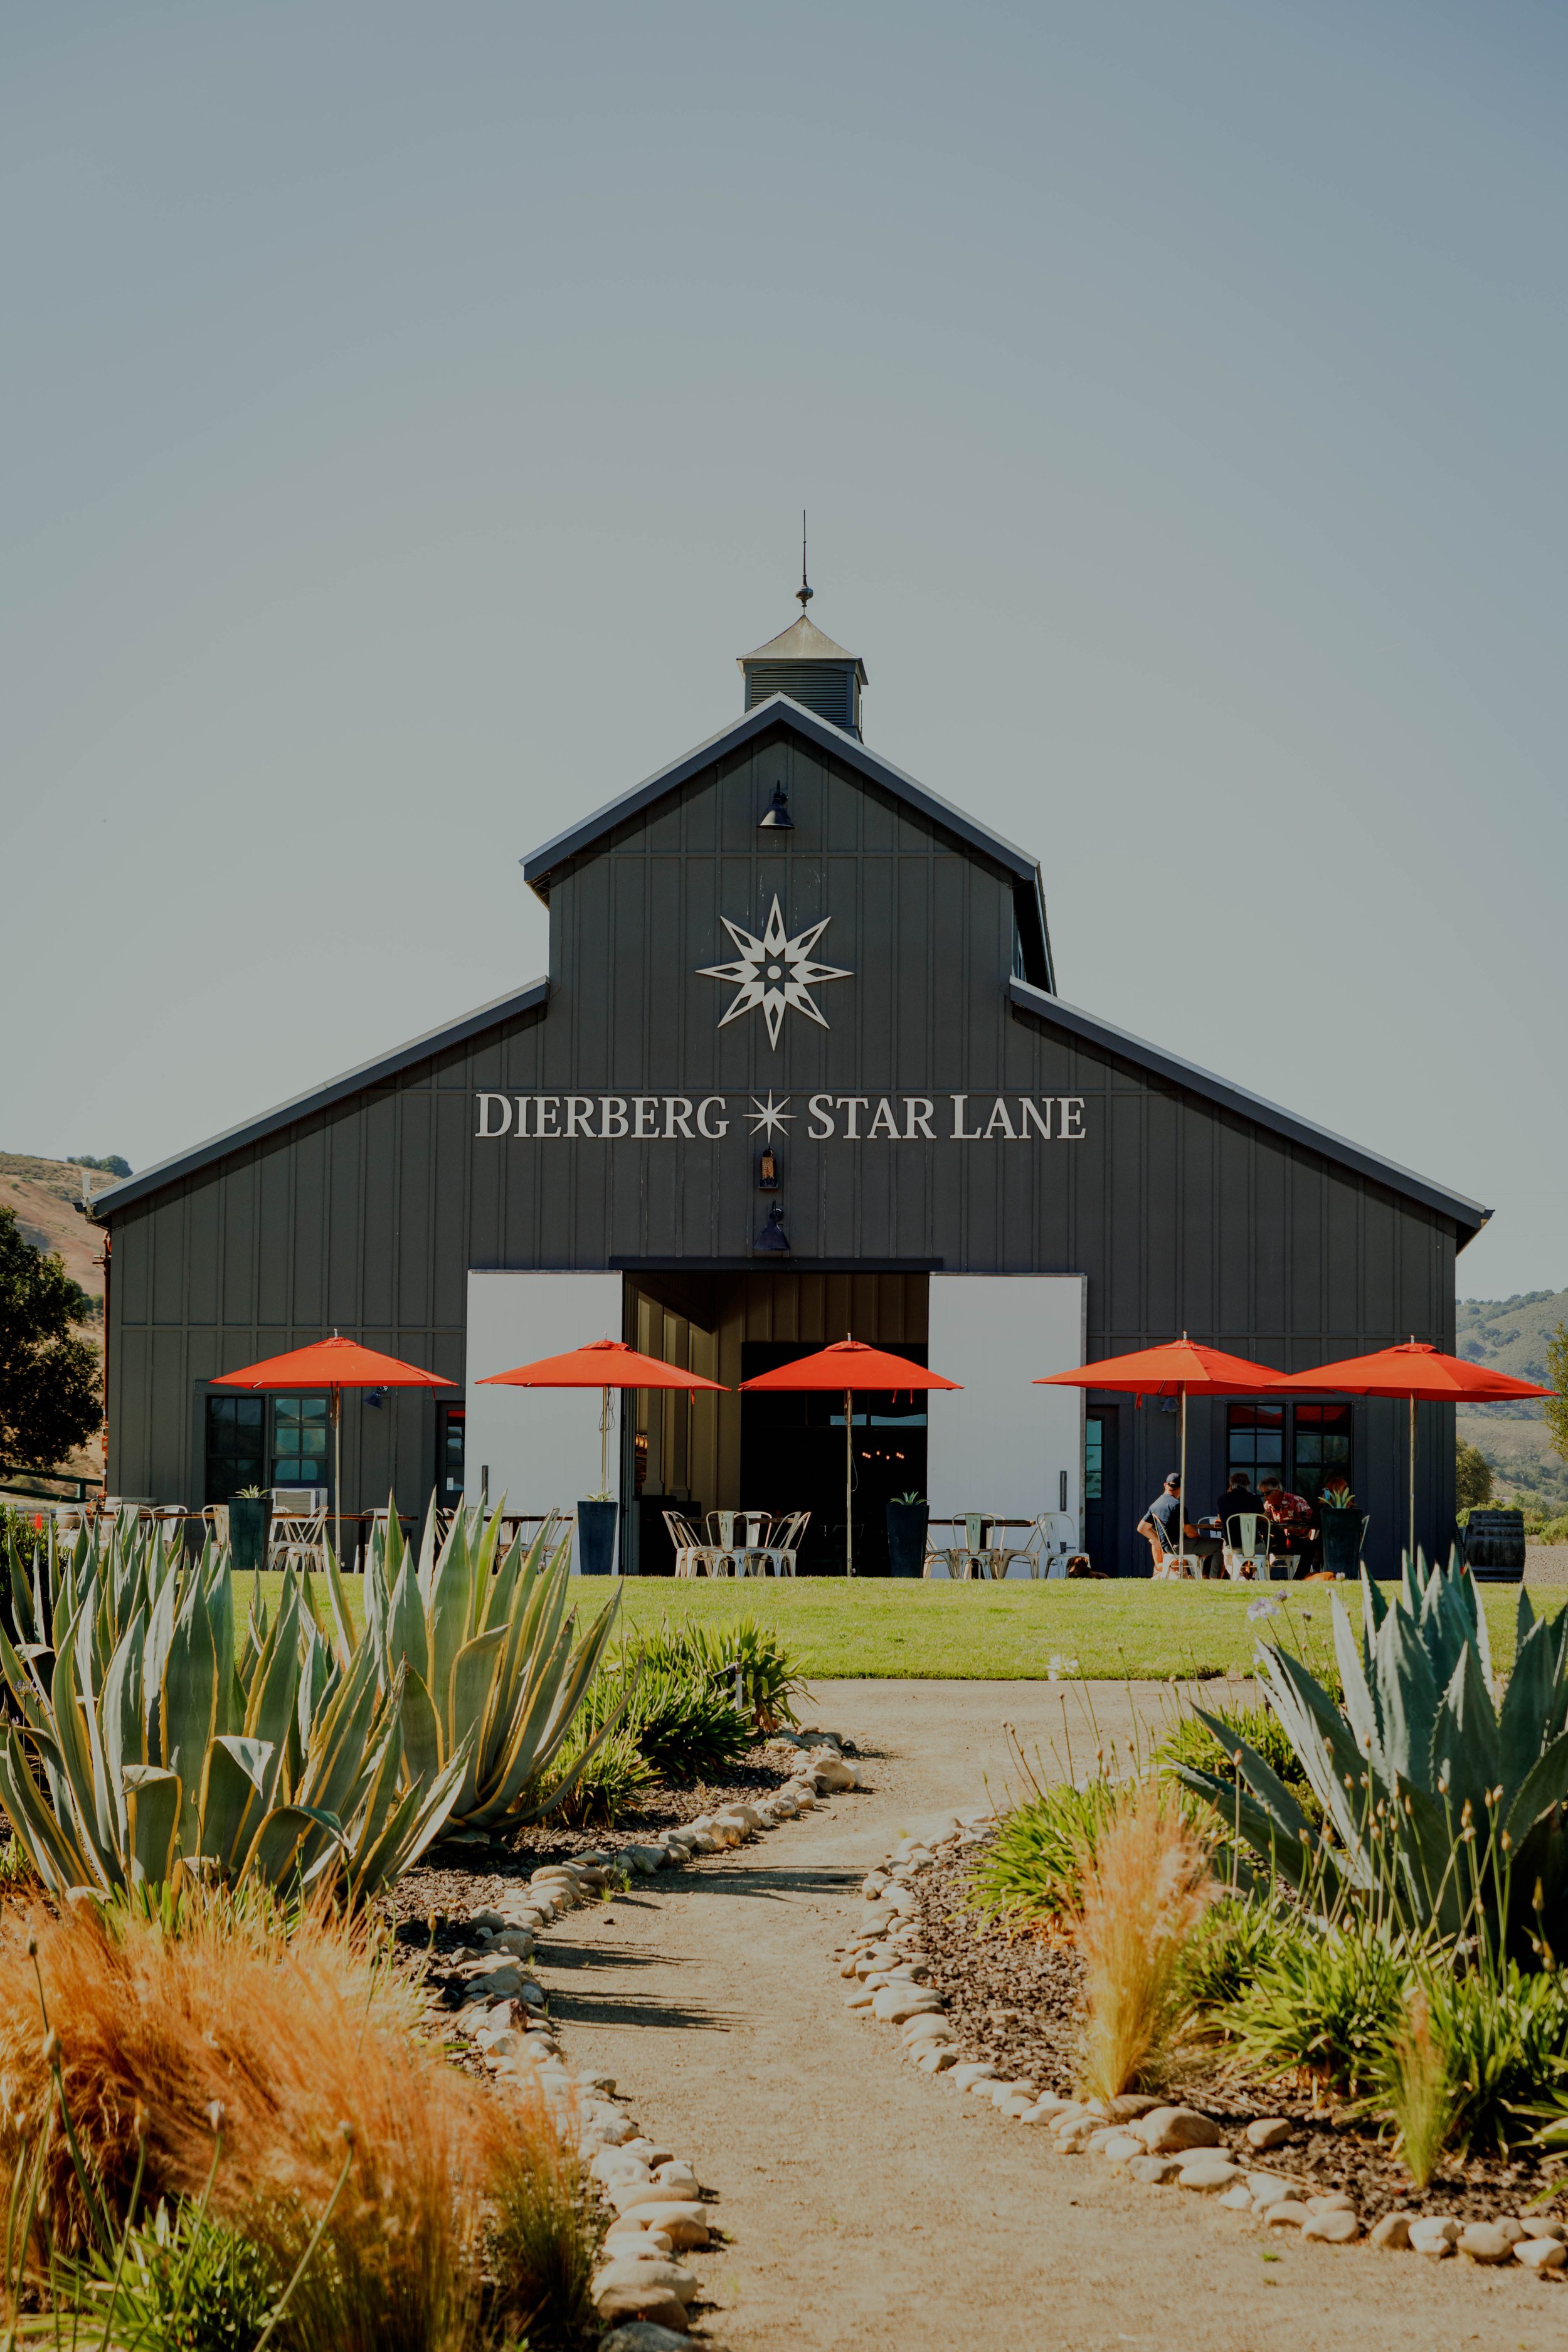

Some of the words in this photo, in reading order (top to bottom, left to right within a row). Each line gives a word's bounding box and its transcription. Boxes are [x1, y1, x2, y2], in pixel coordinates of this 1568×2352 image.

[475, 1093, 729, 1139] DIERBERG
[807, 1094, 936, 1140] STAR
[950, 1094, 1086, 1140] LANE
